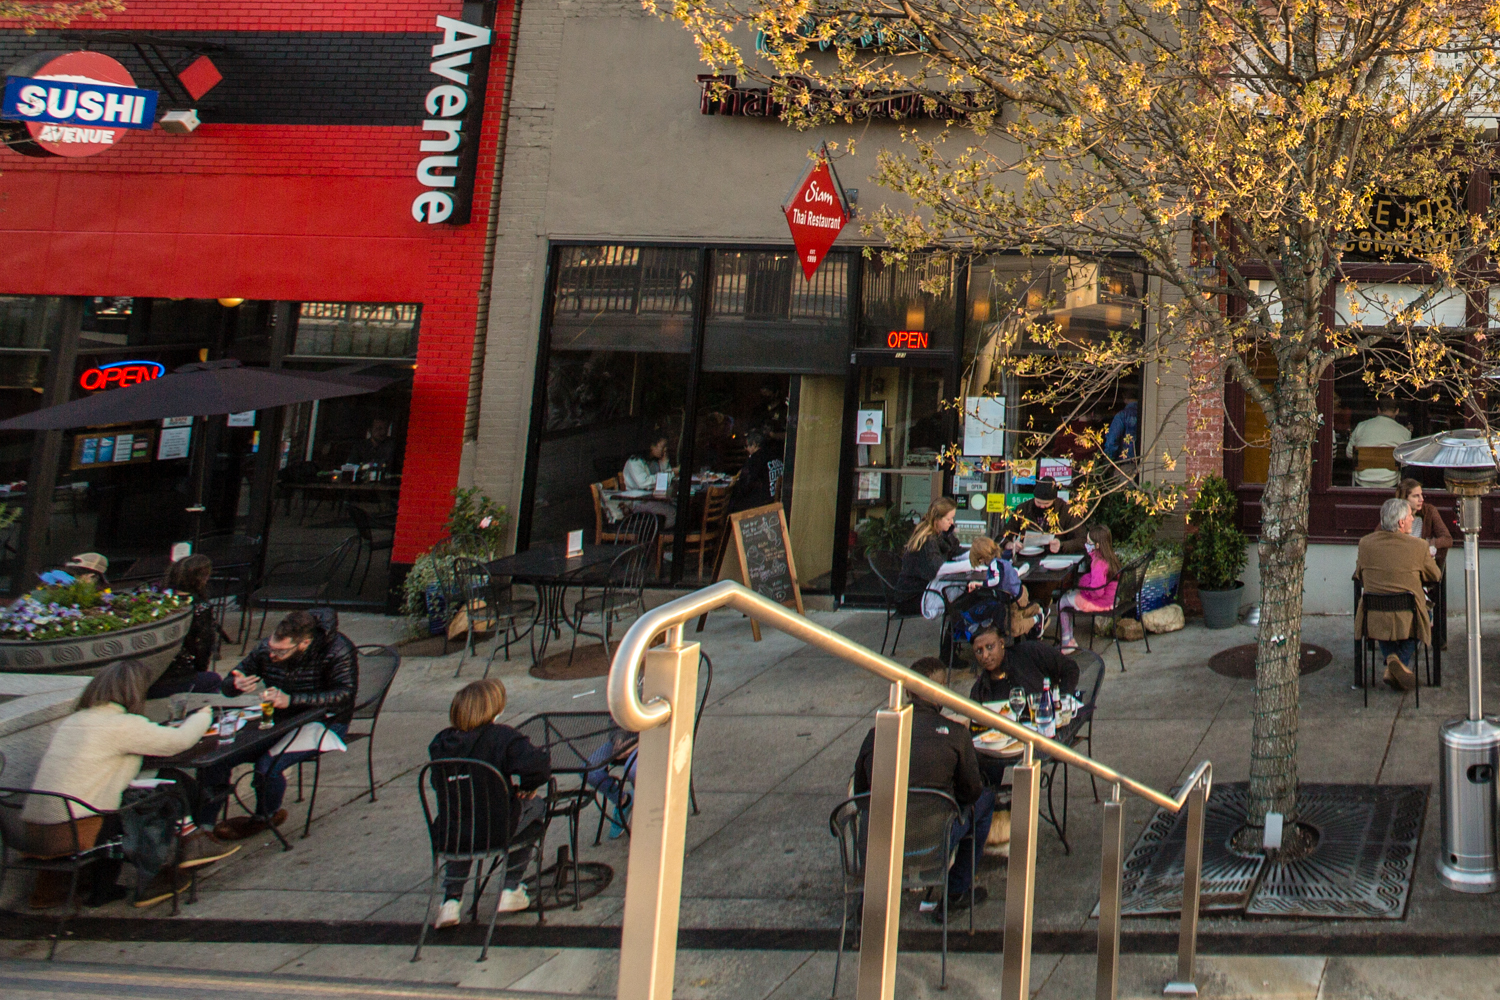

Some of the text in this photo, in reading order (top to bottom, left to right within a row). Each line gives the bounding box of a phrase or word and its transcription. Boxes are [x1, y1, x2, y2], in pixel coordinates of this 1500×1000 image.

[16, 85, 146, 124] SUSHI
[411, 15, 492, 225] Avenue
[38, 125, 115, 144] AVENUE
[805, 180, 833, 206] Siam
[793, 208, 841, 230] Thai Restaurant
[1361, 195, 1459, 226] EJOR
[887, 330, 929, 349] OPEN
[80, 366, 160, 391] OPEN
